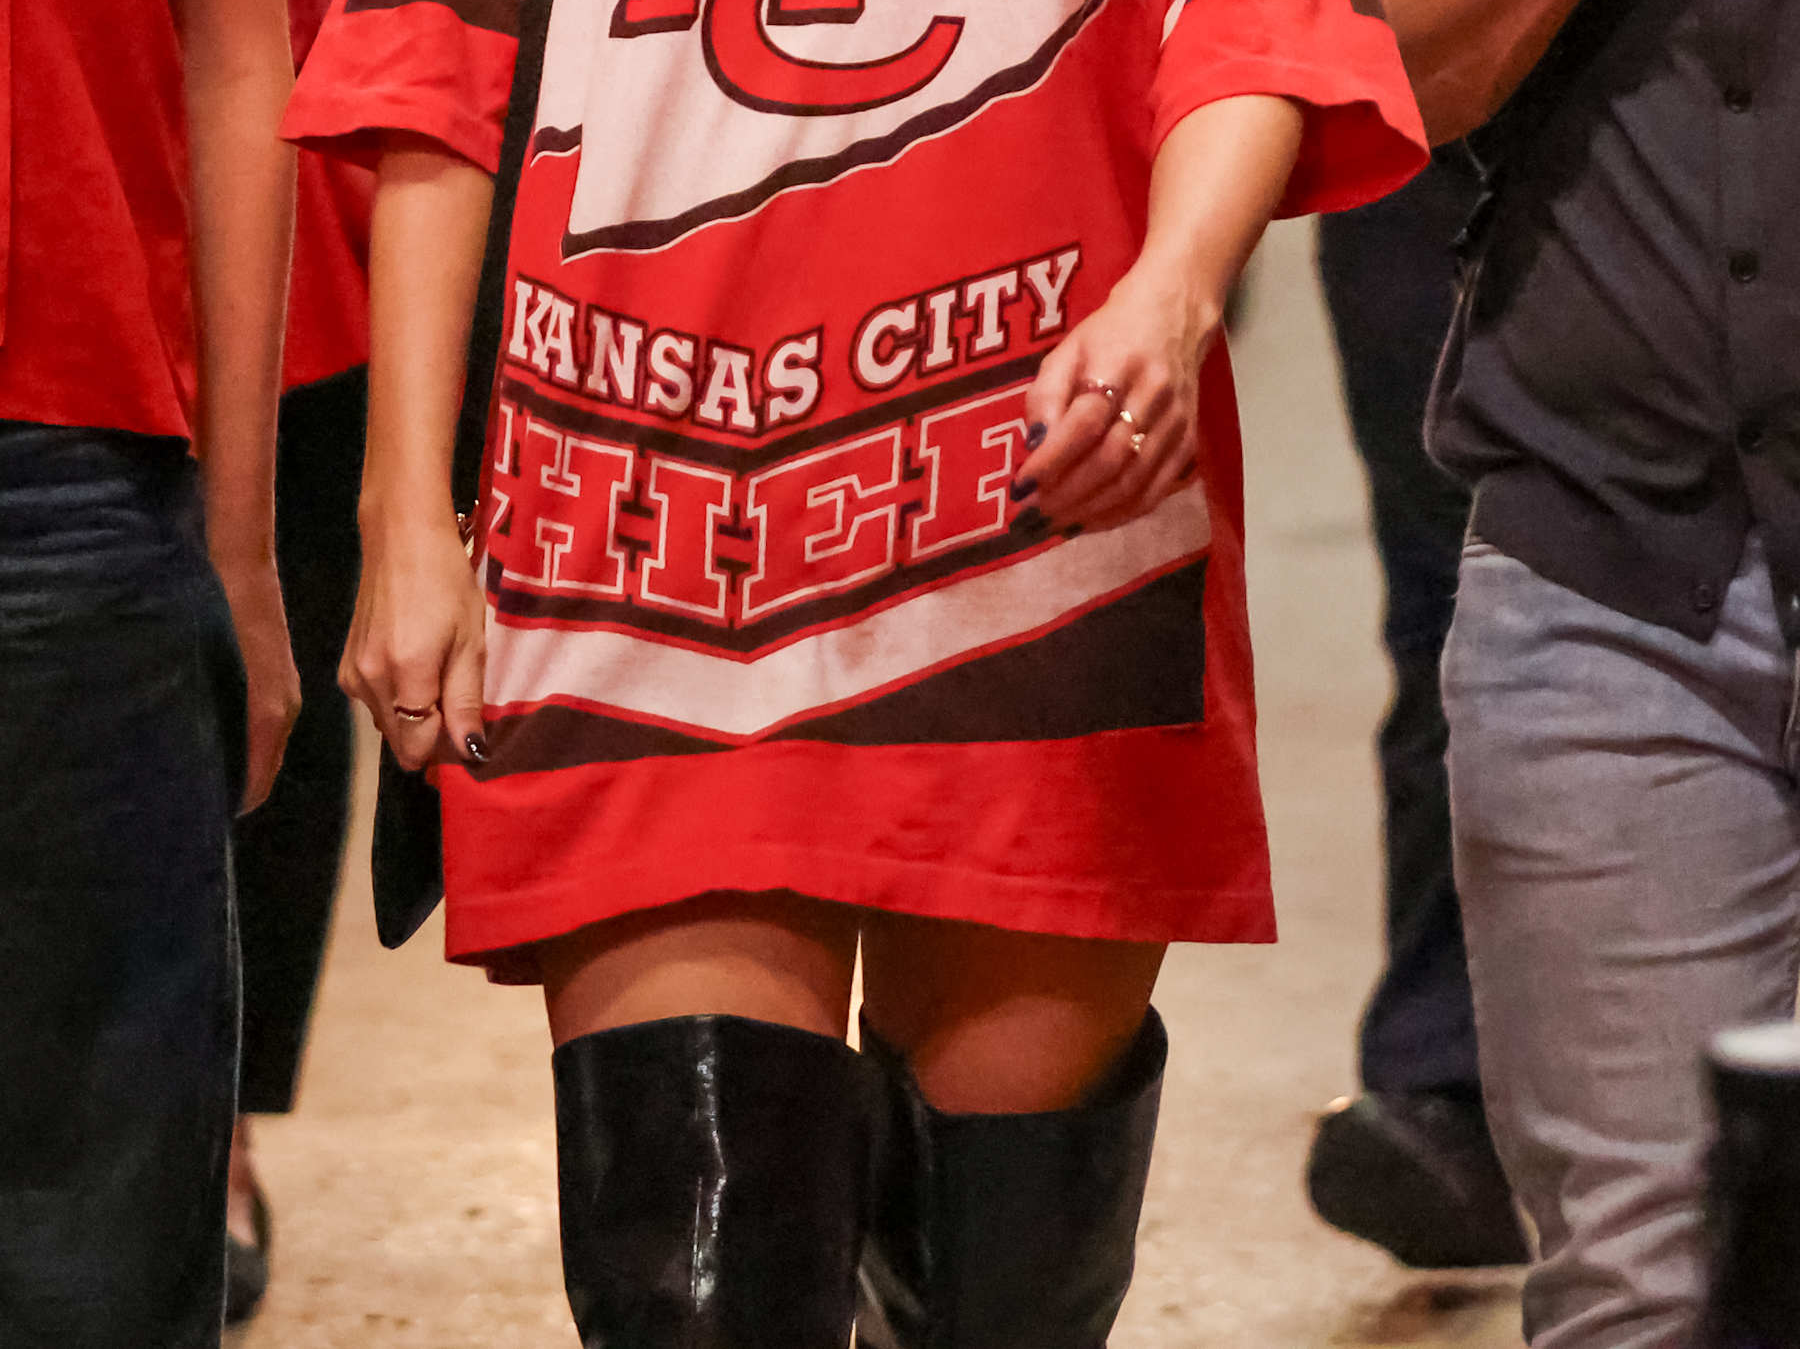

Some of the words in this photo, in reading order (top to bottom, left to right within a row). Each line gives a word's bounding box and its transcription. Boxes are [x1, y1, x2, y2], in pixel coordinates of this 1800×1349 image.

[507, 276, 823, 432] KANSAS
[853, 246, 1081, 388] CITY
[488, 380, 1032, 621] HIEF
